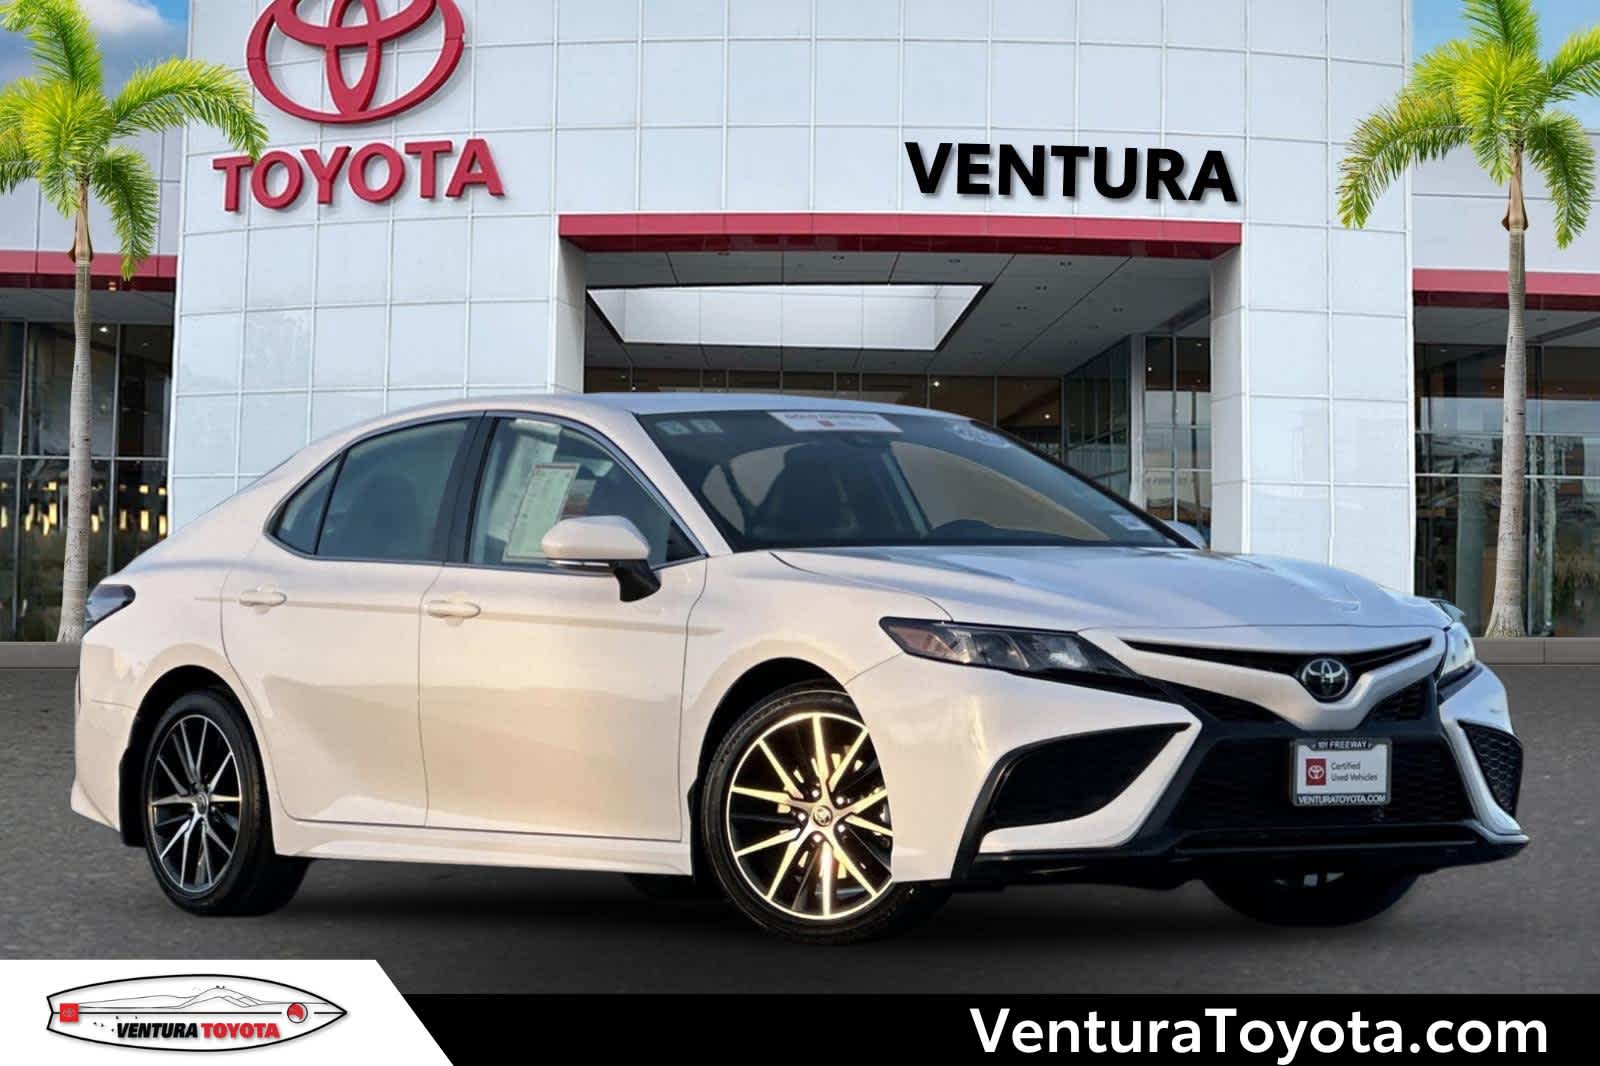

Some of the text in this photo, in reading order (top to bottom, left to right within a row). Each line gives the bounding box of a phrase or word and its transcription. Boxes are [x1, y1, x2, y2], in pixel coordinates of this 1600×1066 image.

[212, 138, 504, 212] TOYOTA
[905, 142, 1238, 202] VENTURA
[1330, 741, 1367, 749] FREEWAY
[1331, 761, 1360, 770] Certified
[1331, 772, 1377, 781] Used Vehicles
[1298, 794, 1386, 804] VENTURATOYOTA.COM
